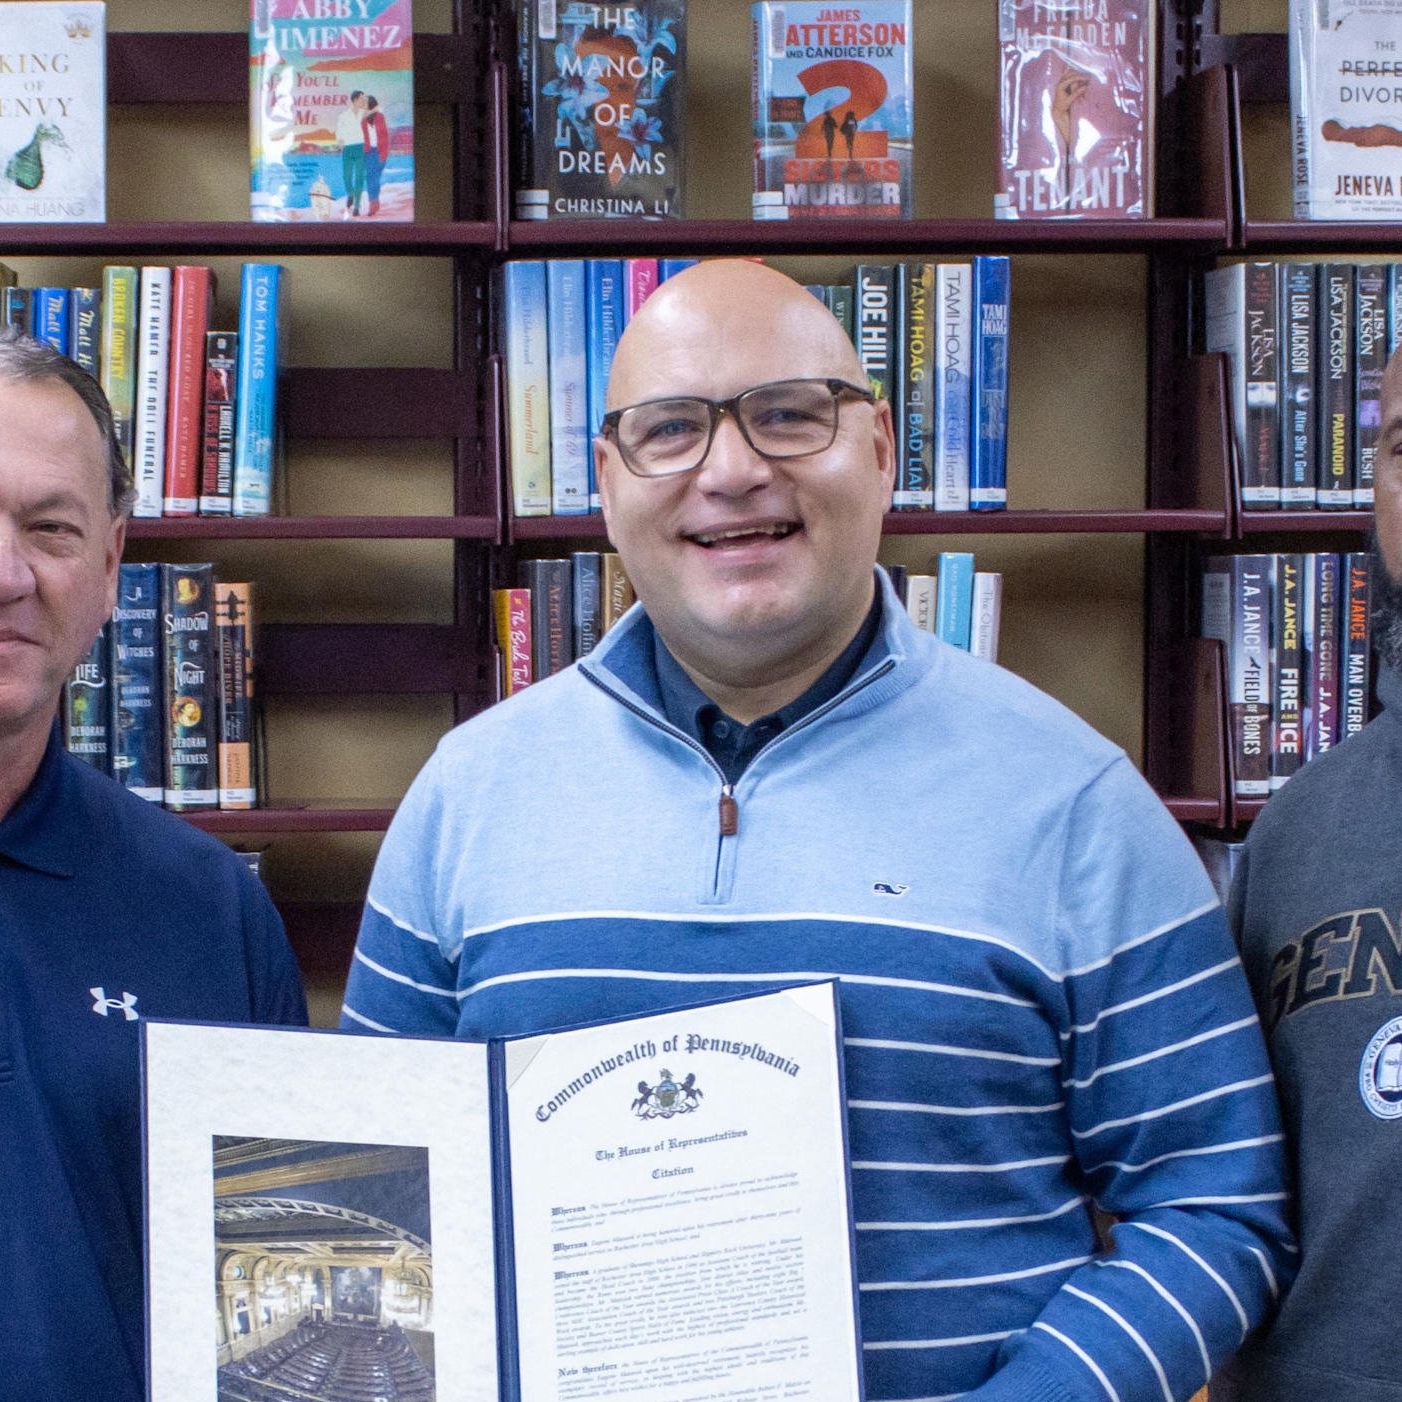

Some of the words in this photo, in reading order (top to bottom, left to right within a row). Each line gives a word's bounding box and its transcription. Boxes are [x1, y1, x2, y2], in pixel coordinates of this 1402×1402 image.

[292, 0, 371, 20] ABBY
[591, 7, 636, 30] THE
[816, 9, 860, 22] JAMES
[279, 26, 402, 50] IMENEZ
[785, 23, 905, 46] ATTERSON
[1374, 41, 1396, 50] THE
[806, 47, 865, 58] CANDICE
[868, 47, 894, 57] FOX
[561, 55, 665, 79] MANOR
[24, 80, 45, 91] OF
[594, 103, 631, 127] OF
[795, 59, 888, 159] 2
[558, 151, 666, 176] DREAMS
[784, 160, 900, 182] SISTERS
[784, 183, 901, 205] MURDER
[1014, 166, 1129, 212] TENANT
[1335, 175, 1394, 196] JENEVA
[27, 203, 85, 217] HUANG
[555, 198, 645, 214] CHRISTINA
[654, 200, 669, 215] LI
[113, 278, 125, 323] BROKEN
[254, 277, 267, 311] TOM
[863, 277, 887, 323] JOE
[911, 277, 924, 318] TAMI
[947, 272, 960, 318] TAMI
[1330, 277, 1342, 306] LISA
[982, 304, 1007, 319] TAMI
[1291, 295, 1309, 319] LISA
[982, 320, 1007, 335] HOAG
[111, 329, 125, 380] COUNTRY
[252, 319, 266, 379] HANKS
[862, 327, 887, 373] HILL
[910, 326, 924, 381] HOAG
[946, 323, 959, 383] HOAG
[1291, 323, 1309, 373] JACKSON
[1330, 310, 1342, 380] JACKSON
[909, 414, 923, 451] BAD
[1332, 413, 1344, 476] PARANOID
[1321, 561, 1333, 603] LONG
[165, 612, 208, 634] SHADOW
[1244, 605, 1261, 654] JANCE
[1284, 601, 1296, 650] JANCE
[1350, 599, 1366, 640] JANCE
[1349, 654, 1364, 683] MAN
[1281, 668, 1297, 710] FIRE
[71, 726, 105, 737] DEBORAH
[172, 738, 206, 748] DEBORAH
[1244, 714, 1261, 755] BONES
[1280, 722, 1297, 753] ICE
[69, 742, 107, 752] HARKNESS
[171, 753, 209, 764] HARKNESS
[535, 1038, 656, 1122] Commonwealth
[662, 1035, 679, 1053] of
[684, 1032, 800, 1077] Pennsylvania
[595, 1150, 614, 1162] The
[618, 1143, 650, 1159] House
[654, 1140, 664, 1152] of
[668, 1129, 748, 1150] Representatives
[652, 1165, 694, 1180] Citation
[551, 1204, 586, 1217] Whereas
[553, 1241, 587, 1253] Whereas
[554, 1269, 589, 1280] Whereas
[558, 1367, 578, 1377] Now
[582, 1363, 617, 1374] therefore
